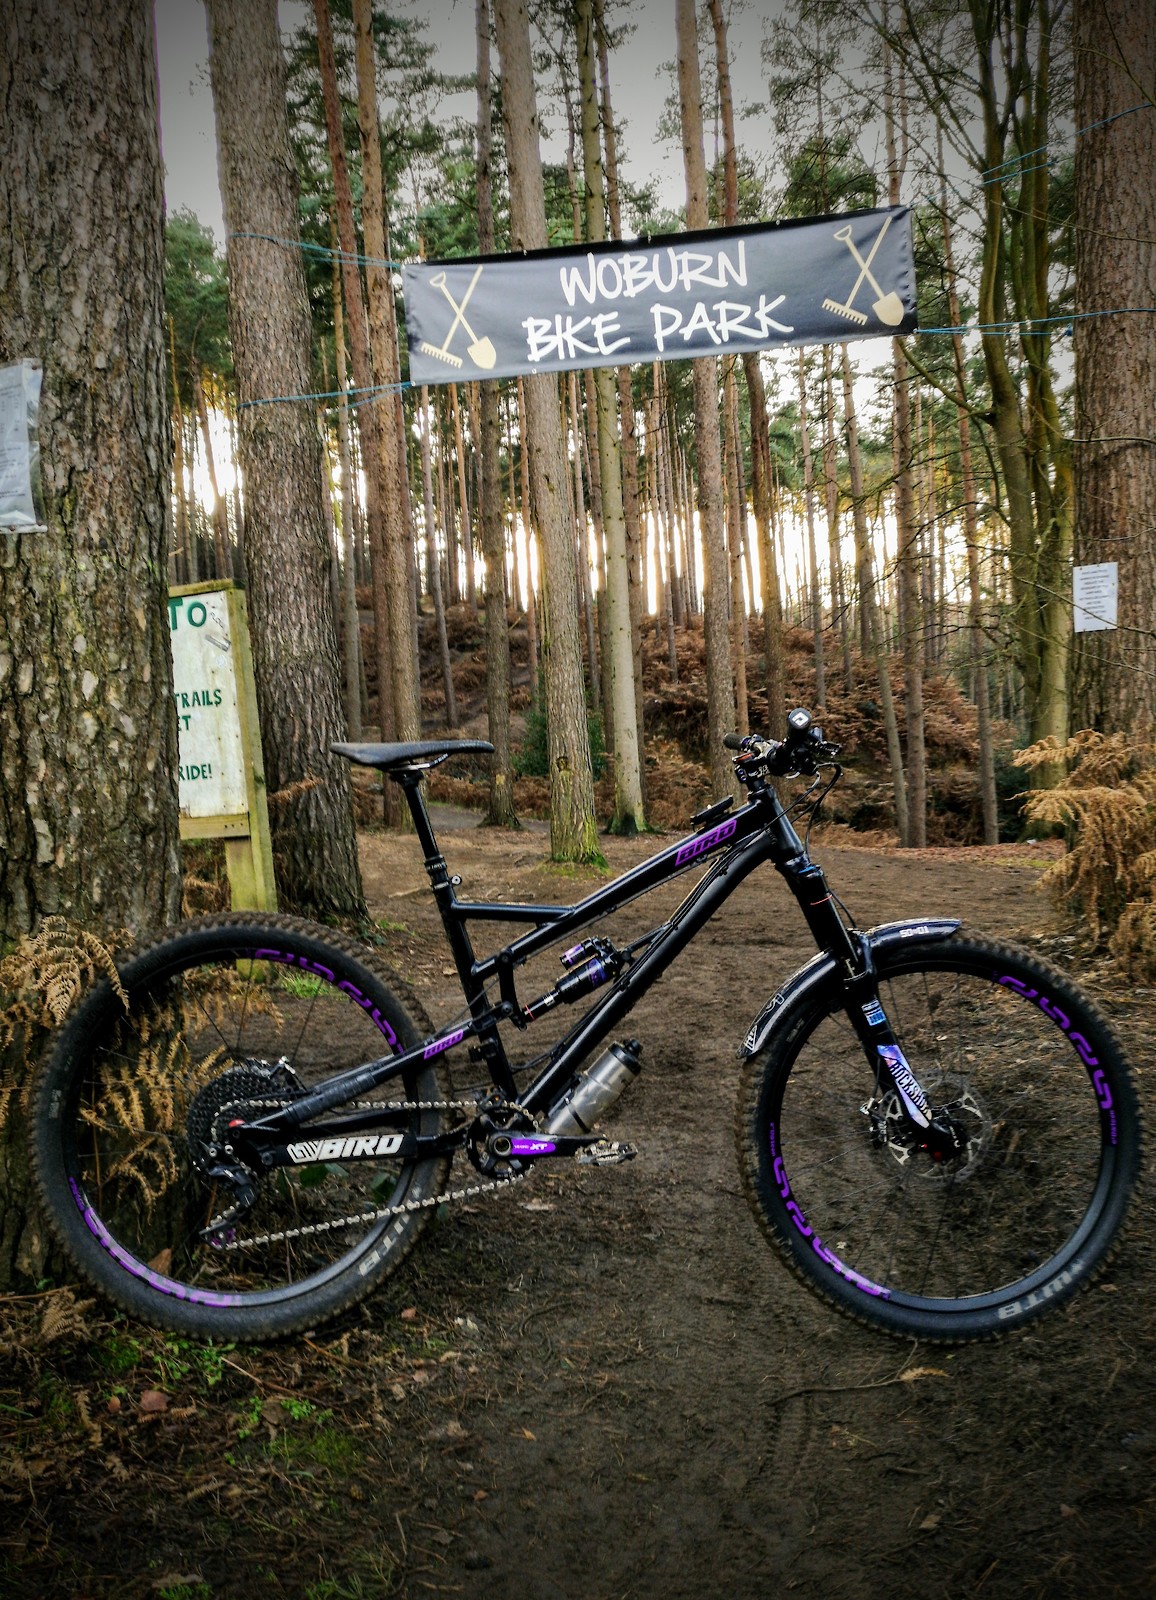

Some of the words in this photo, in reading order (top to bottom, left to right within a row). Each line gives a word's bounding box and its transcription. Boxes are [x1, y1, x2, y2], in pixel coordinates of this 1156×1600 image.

[560, 240, 748, 305] WOBURN
[522, 311, 631, 361] BIKE
[650, 295, 794, 351] PARK
[167, 597, 207, 630] TO
[318, 1134, 404, 1160] BIRD
